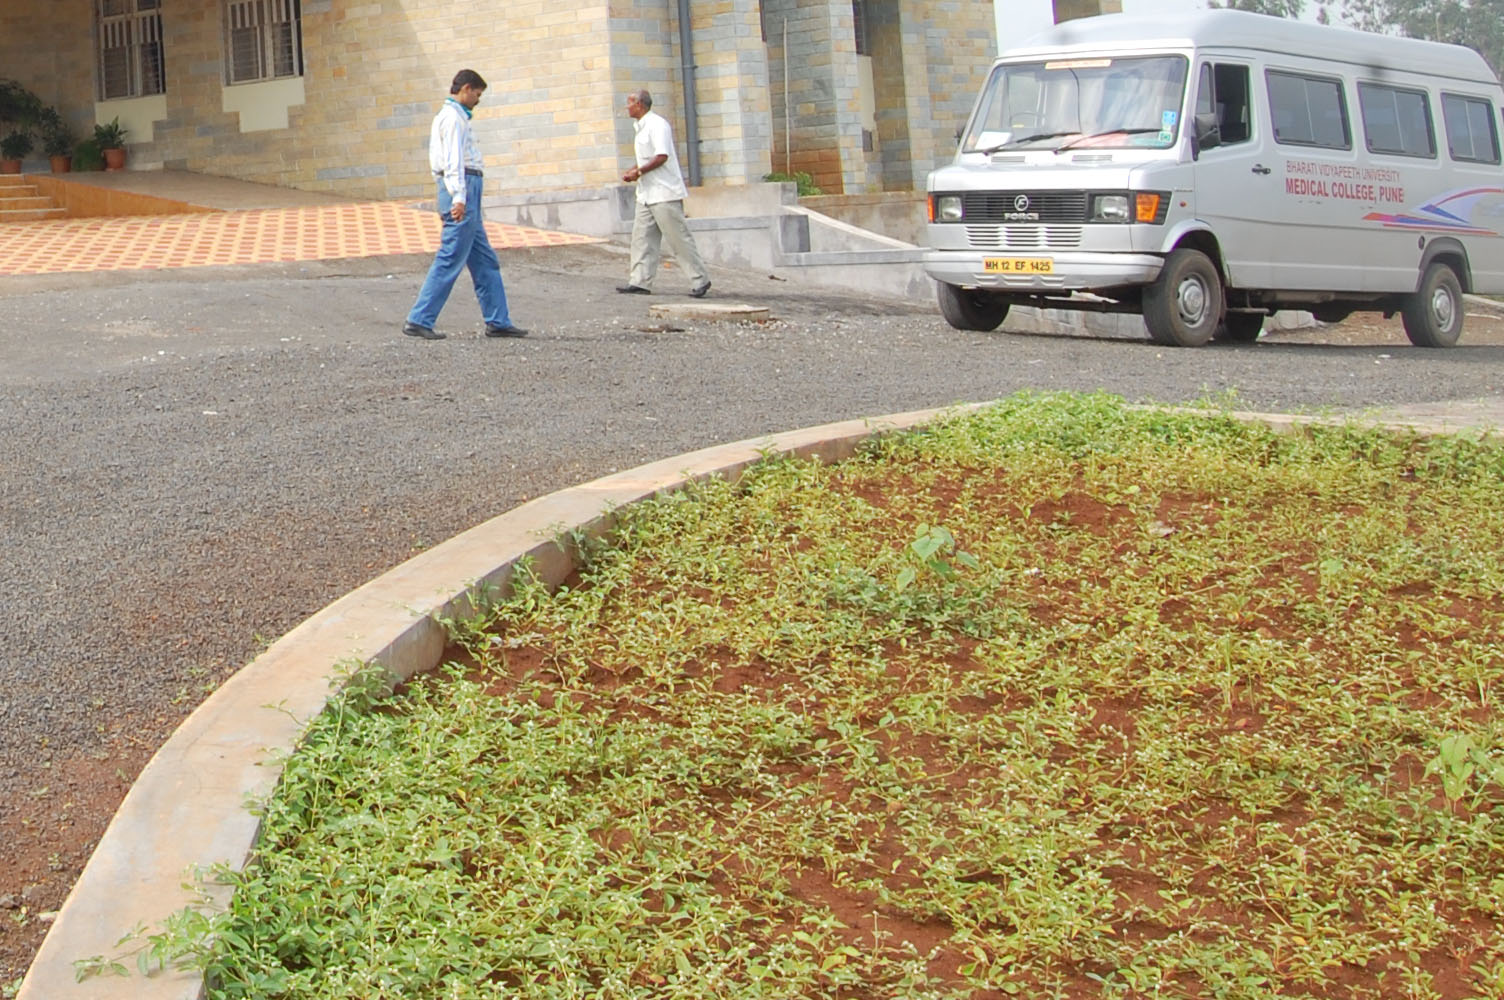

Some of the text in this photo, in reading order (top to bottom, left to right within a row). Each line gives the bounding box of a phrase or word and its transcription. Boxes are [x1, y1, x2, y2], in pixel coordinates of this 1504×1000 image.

[1286, 160, 1316, 176] BHARATI
[1285, 178, 1404, 204] MEDICAL COLLEGE, PUNE
[1004, 212, 1039, 221] FORCE
[985, 261, 1050, 272] MH 12 EF 1425
